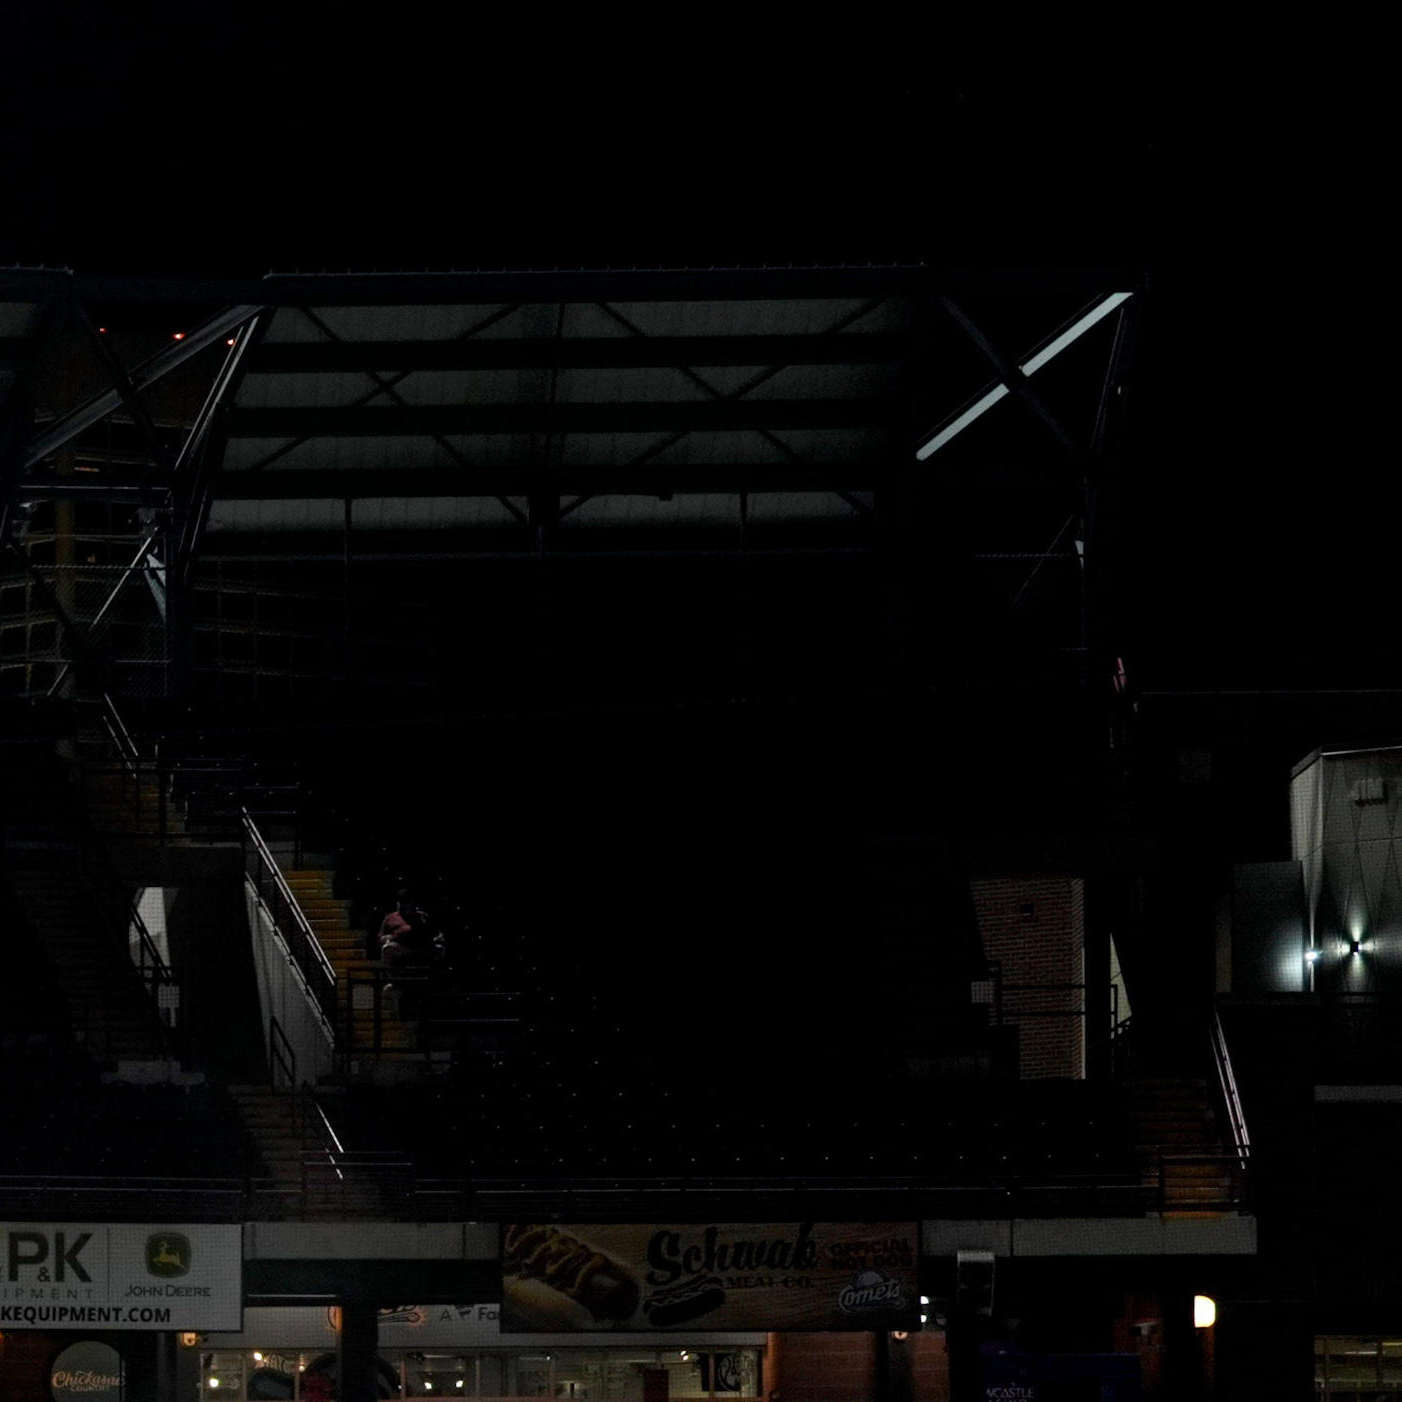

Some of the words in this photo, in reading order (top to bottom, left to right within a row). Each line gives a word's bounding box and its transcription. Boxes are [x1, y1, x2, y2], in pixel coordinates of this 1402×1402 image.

[648, 1220, 820, 1285] Schwab
[125, 1284, 164, 1297] JOHN
[165, 1285, 212, 1298] DEERE
